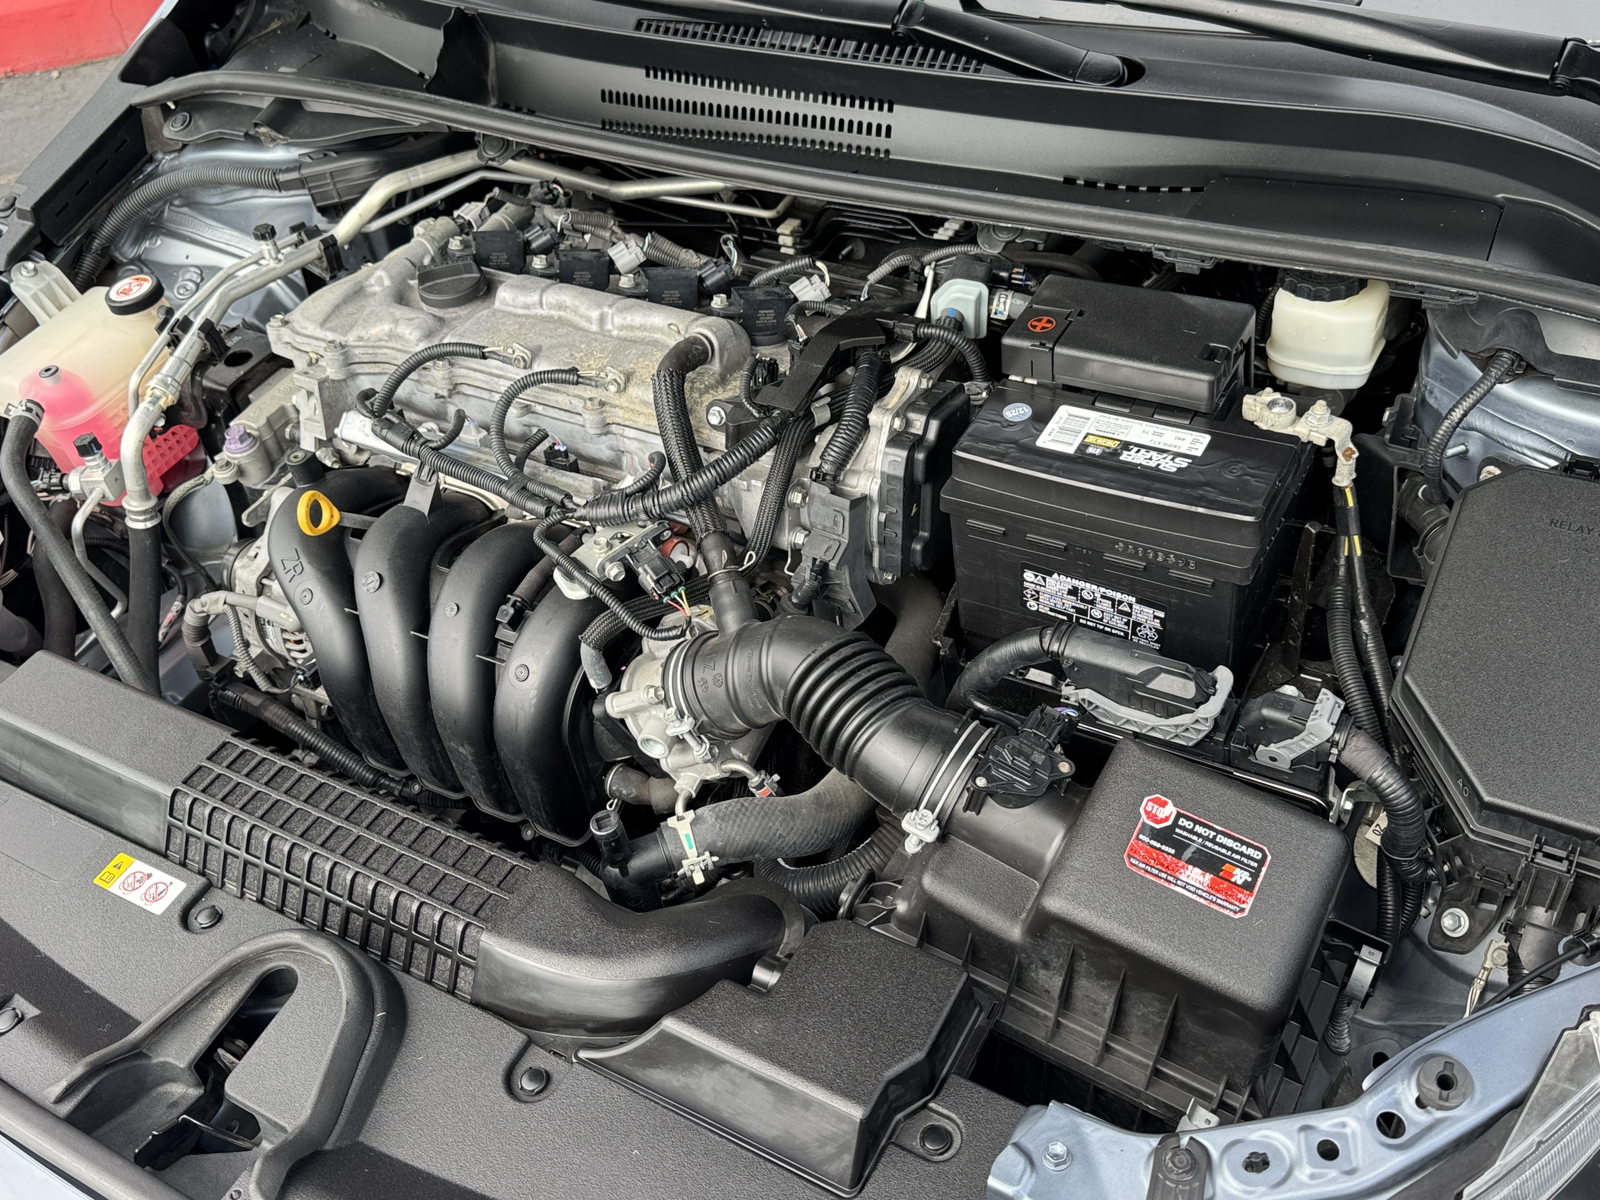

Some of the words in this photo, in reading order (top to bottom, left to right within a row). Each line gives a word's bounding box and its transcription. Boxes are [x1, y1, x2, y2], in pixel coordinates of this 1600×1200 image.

[1117, 452, 1180, 472] SUPER
[1126, 446, 1193, 467] START
[1548, 518, 1595, 536] RELAY
[1059, 574, 1136, 602] DANGER/POISON
[1174, 827, 1203, 843] WASHABLE
[1204, 840, 1231, 856] REUSABLE
[1230, 852, 1241, 860] AIR
[1240, 856, 1258, 868] FILTER
[1177, 816, 1194, 830] DO
[1193, 824, 1217, 840] NOT
[1215, 833, 1263, 860] DISCARD
